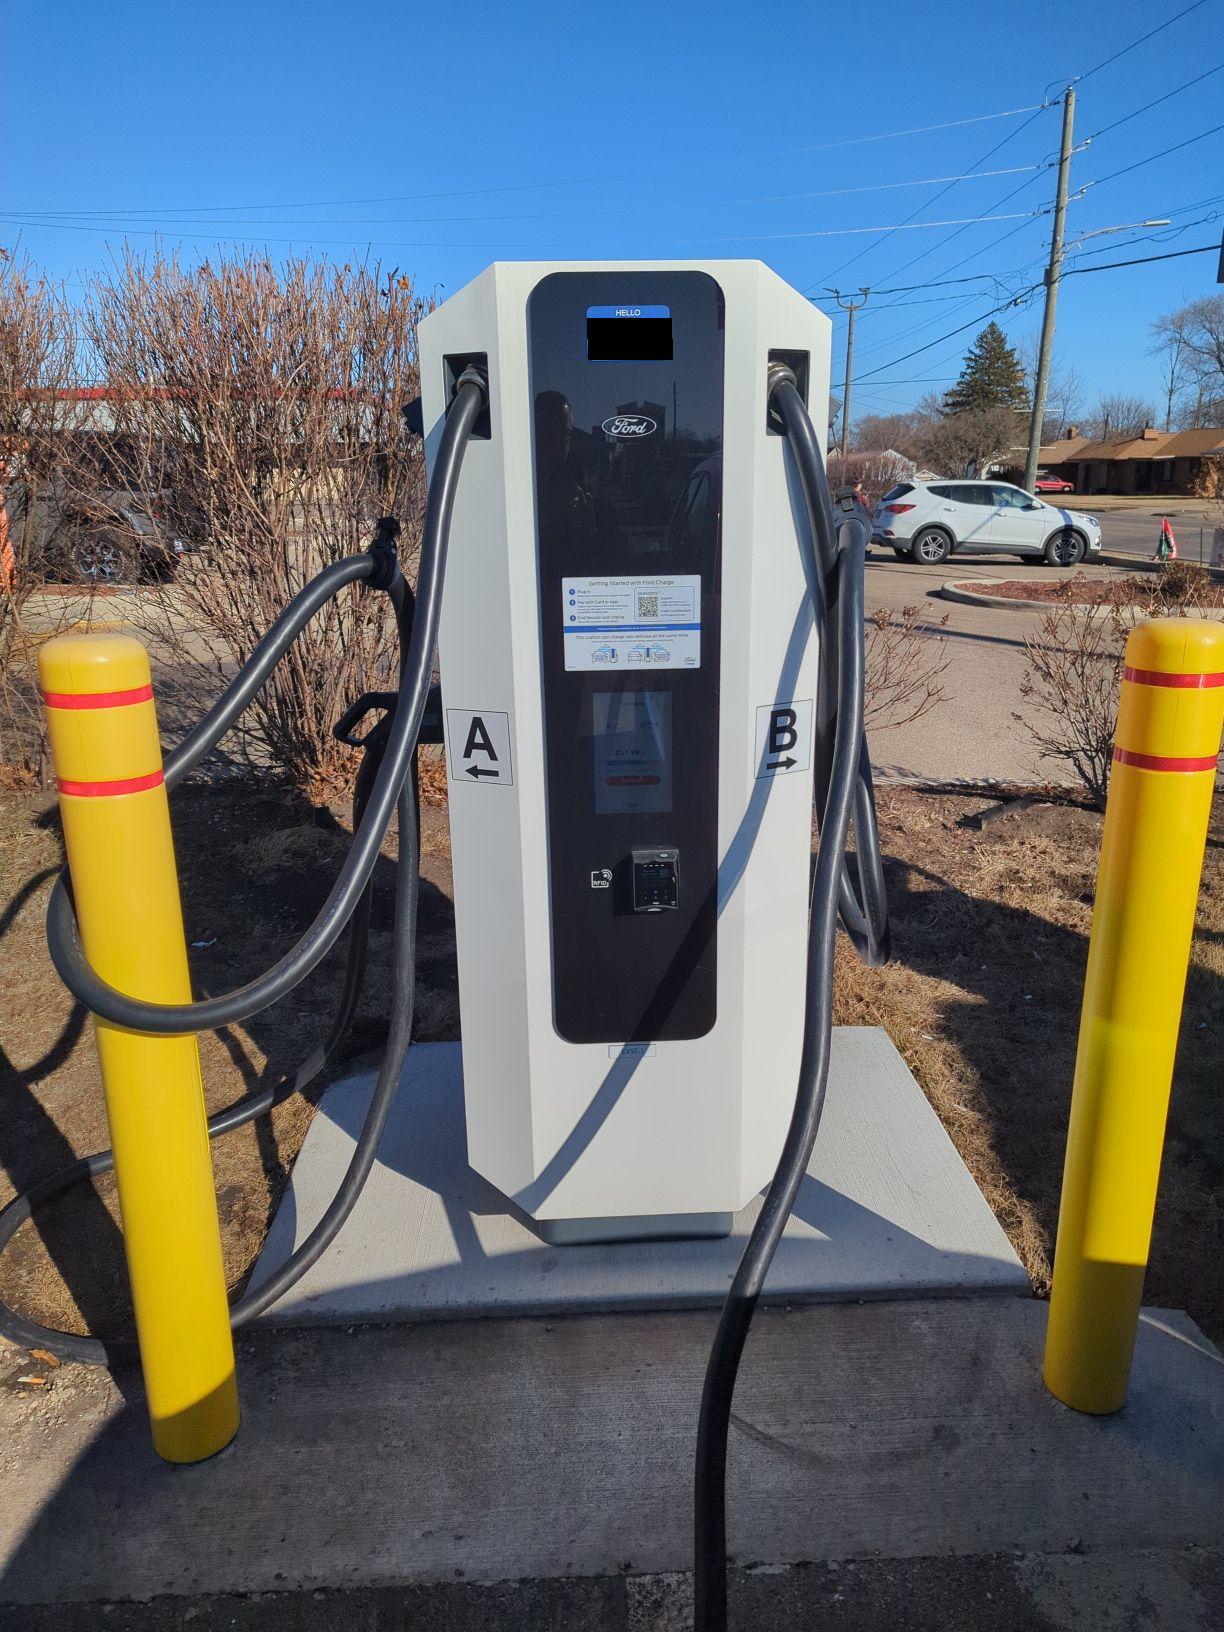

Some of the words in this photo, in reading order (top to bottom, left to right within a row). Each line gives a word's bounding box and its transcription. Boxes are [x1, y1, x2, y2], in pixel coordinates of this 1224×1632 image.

[615, 309, 641, 317] HELLO
[610, 417, 648, 434] Ford
[463, 716, 499, 762] A
[768, 708, 798, 754] B
